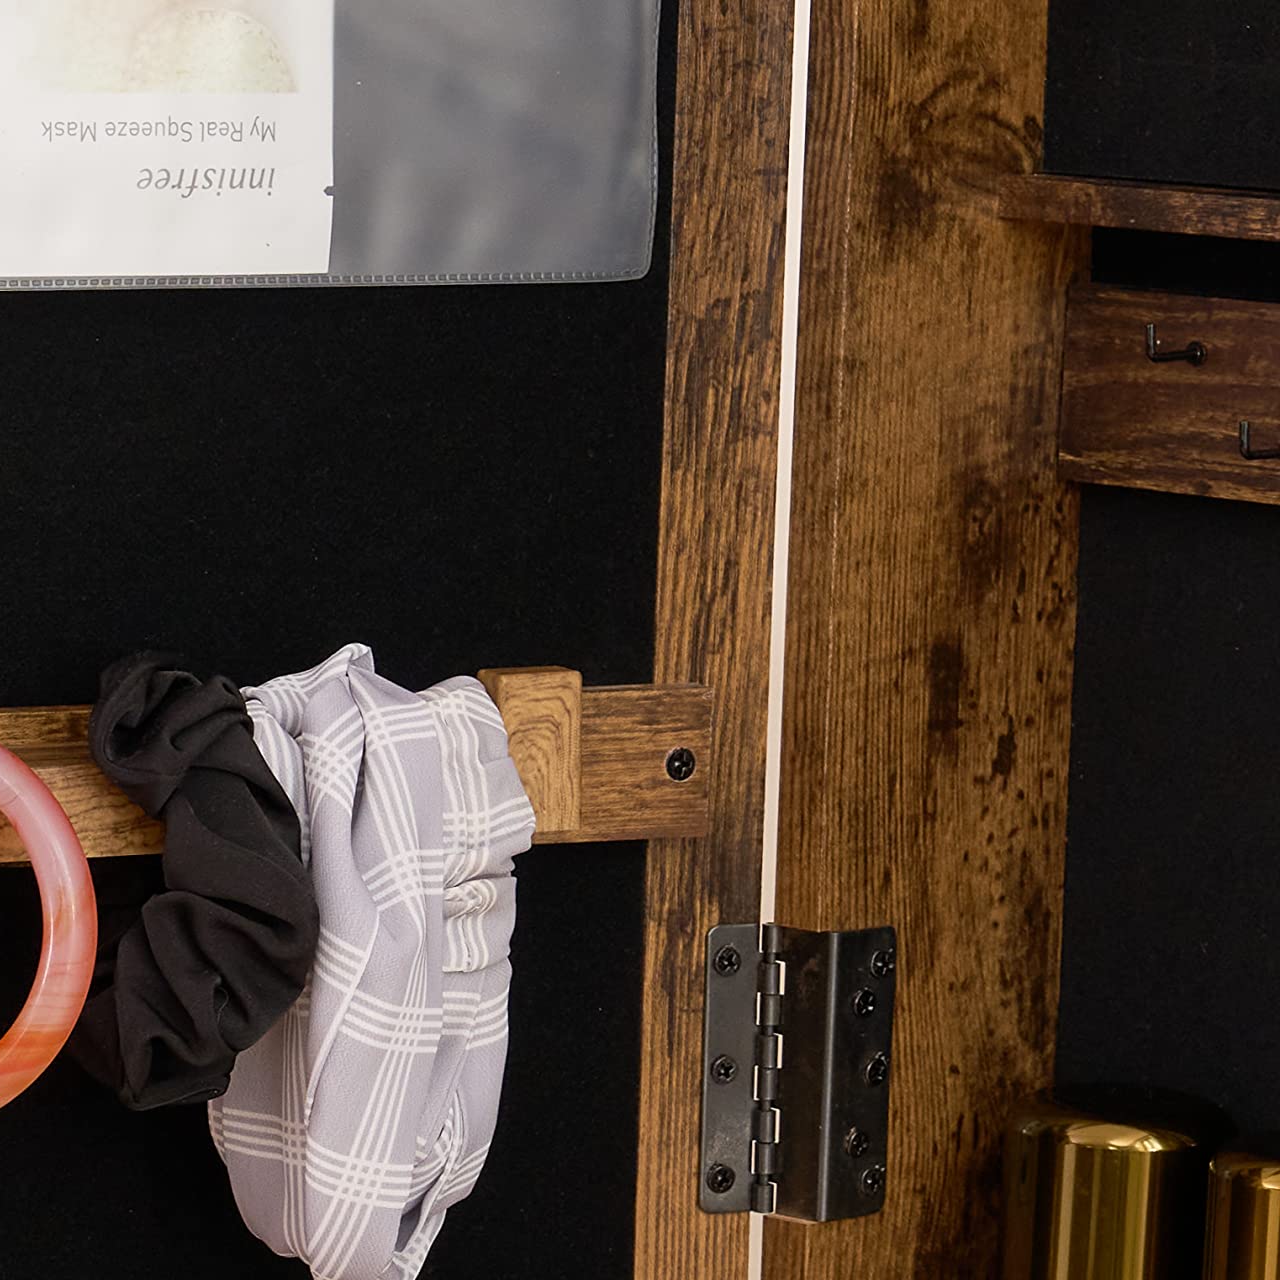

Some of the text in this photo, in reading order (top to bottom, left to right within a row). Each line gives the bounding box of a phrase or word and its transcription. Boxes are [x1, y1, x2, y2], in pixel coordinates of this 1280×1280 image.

[41, 115, 276, 142] My Real Squeeze Mask
[136, 168, 276, 199] innisfree
